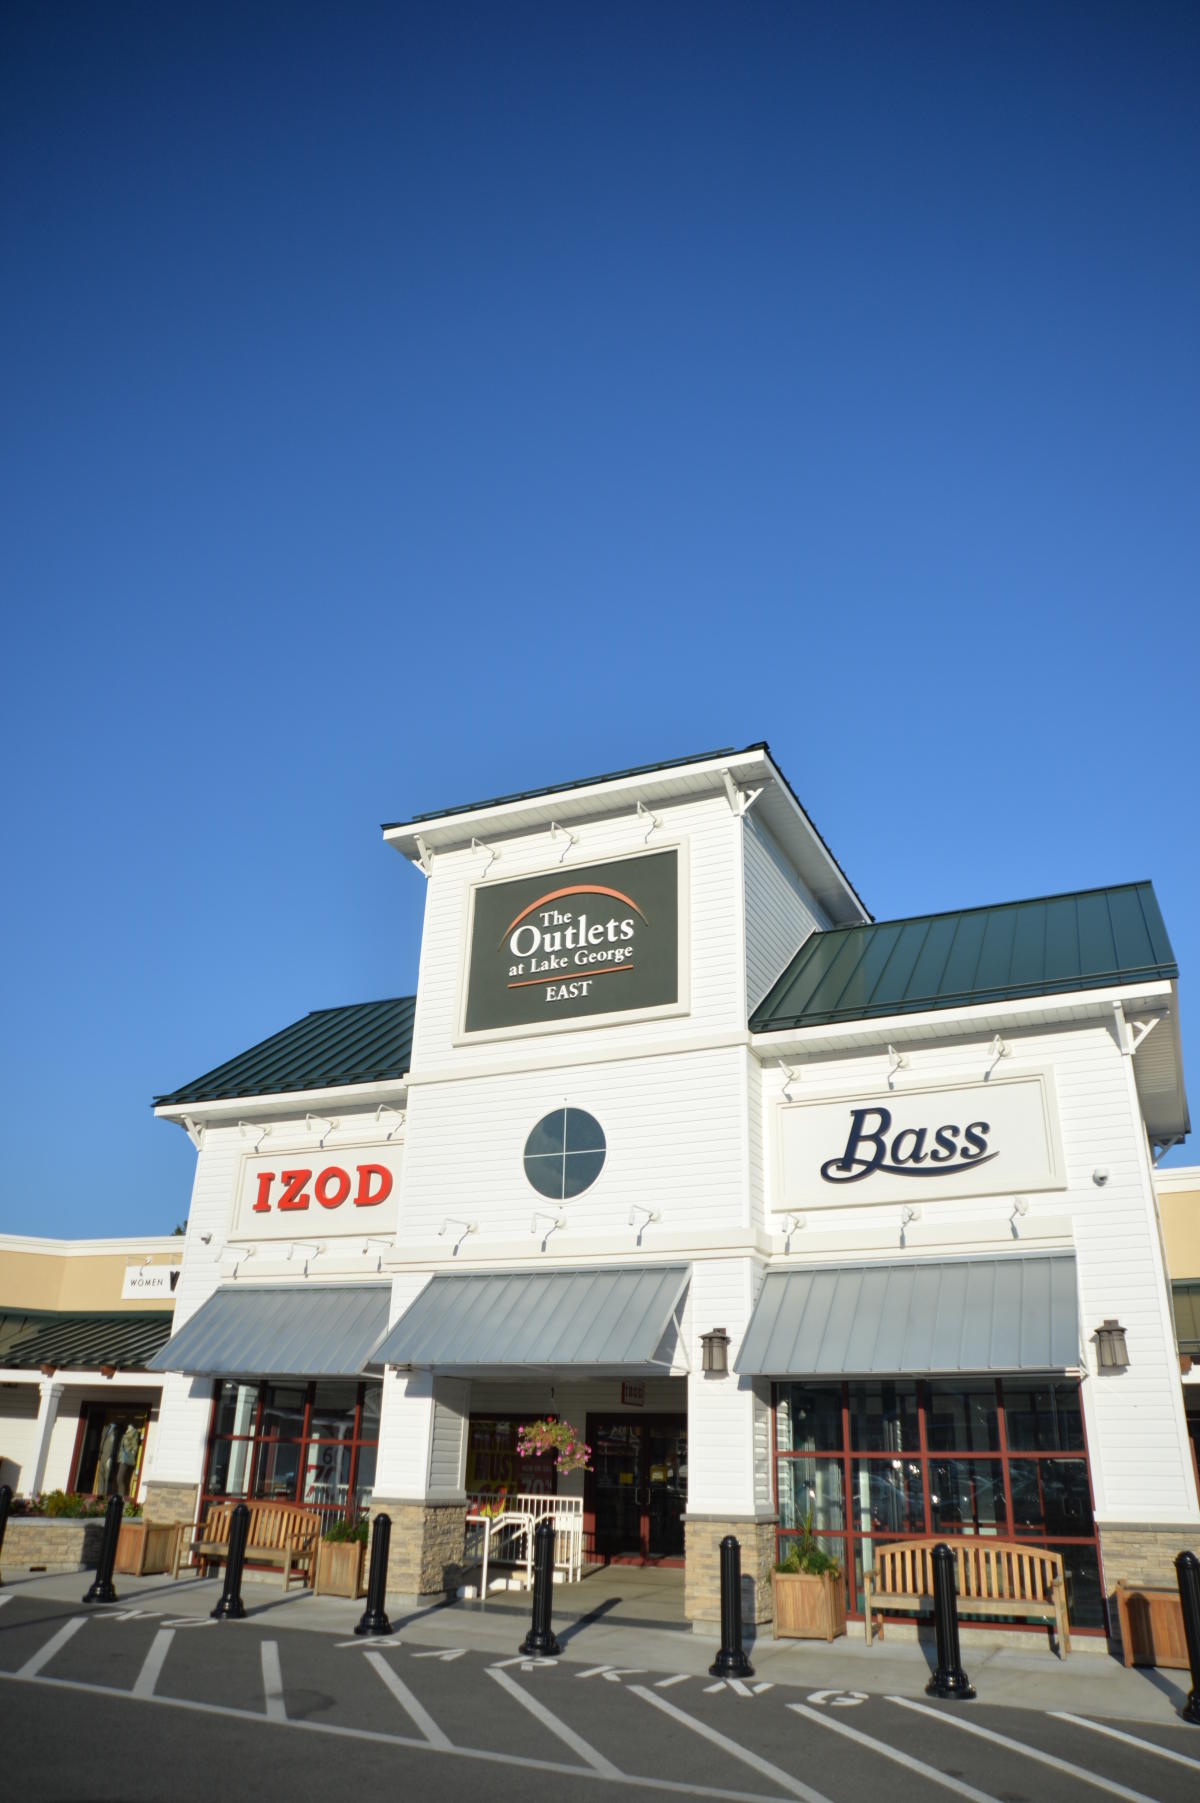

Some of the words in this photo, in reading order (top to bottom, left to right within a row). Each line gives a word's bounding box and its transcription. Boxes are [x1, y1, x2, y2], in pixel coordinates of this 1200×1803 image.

[540, 910, 572, 928] The
[510, 914, 635, 958] Outlets
[508, 962, 525, 977] at
[530, 955, 569, 973] Lake
[574, 946, 634, 966] George
[545, 980, 593, 1002] EAST
[820, 1106, 1000, 1185] Bass
[252, 1163, 394, 1213] IZOD
[130, 1278, 164, 1287] WOMEN
